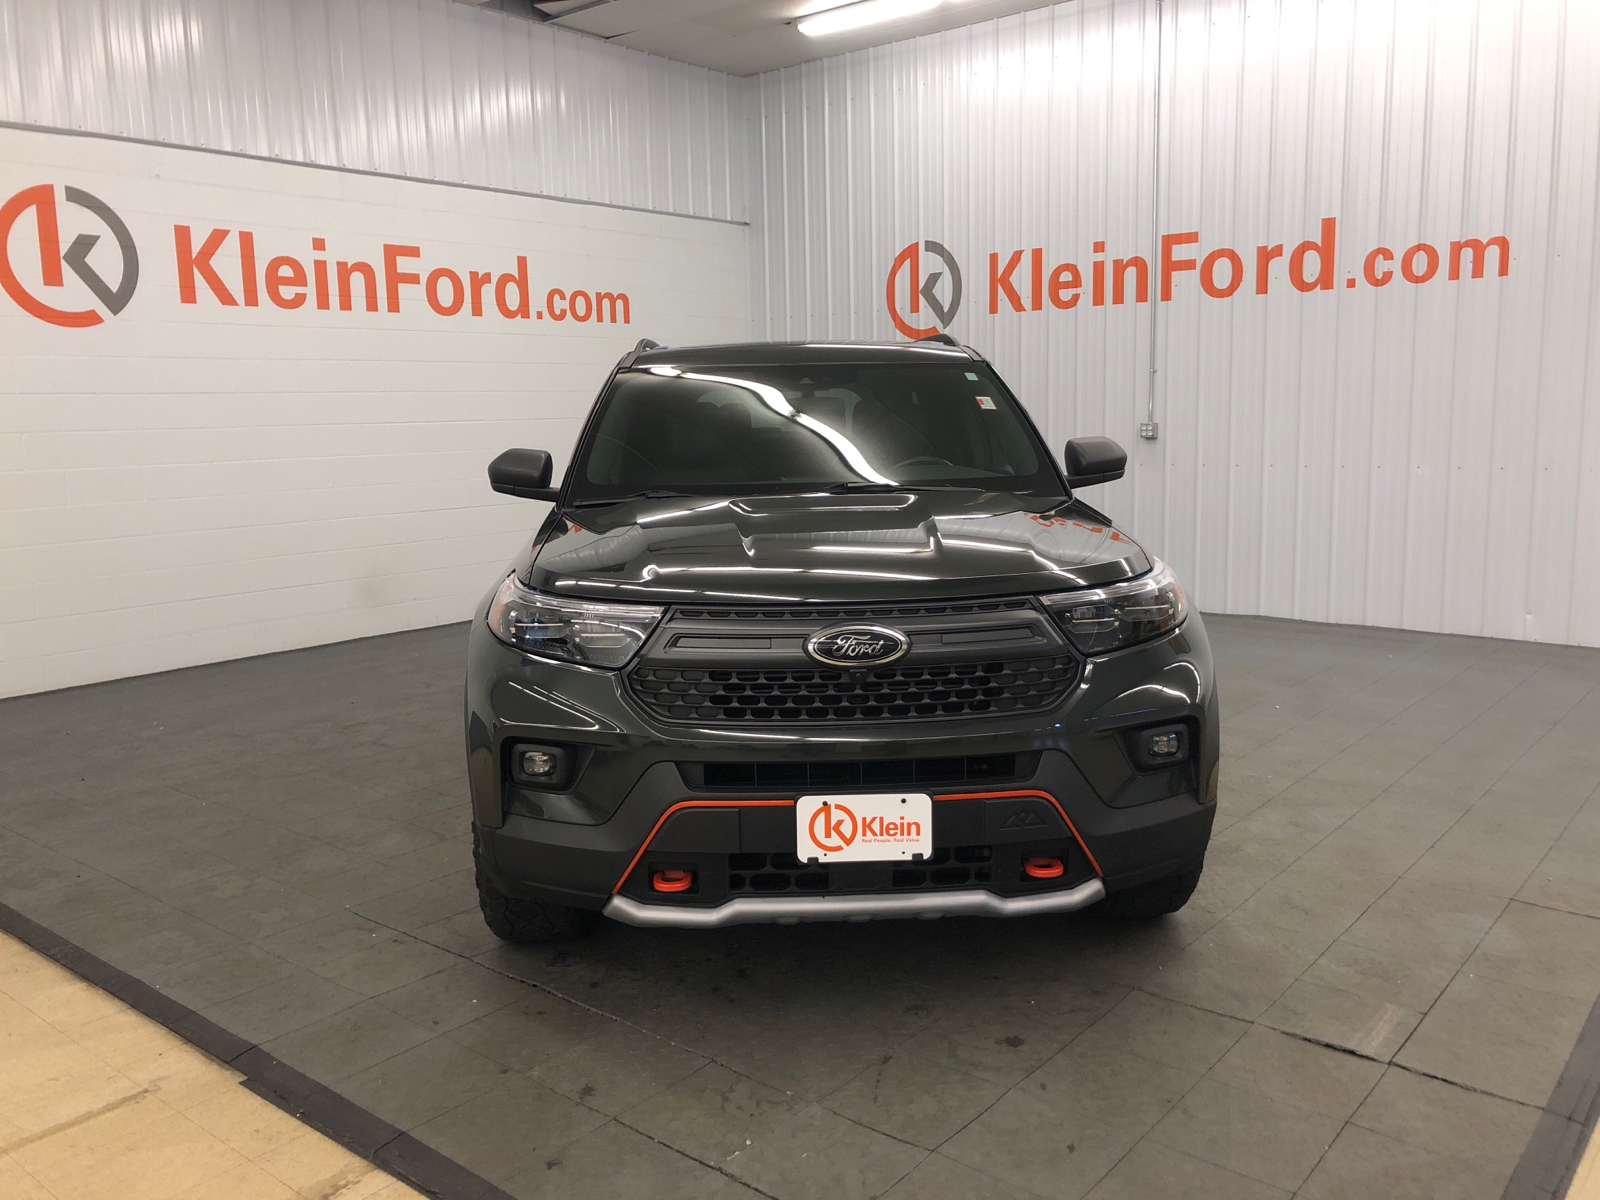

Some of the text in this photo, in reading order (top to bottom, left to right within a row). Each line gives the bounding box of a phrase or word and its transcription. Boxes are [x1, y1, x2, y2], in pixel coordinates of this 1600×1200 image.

[173, 224, 631, 325] KleinFord.com
[988, 217, 1510, 315] KleinFord.com
[832, 634, 885, 656] Ford
[861, 816, 921, 837] Klein
